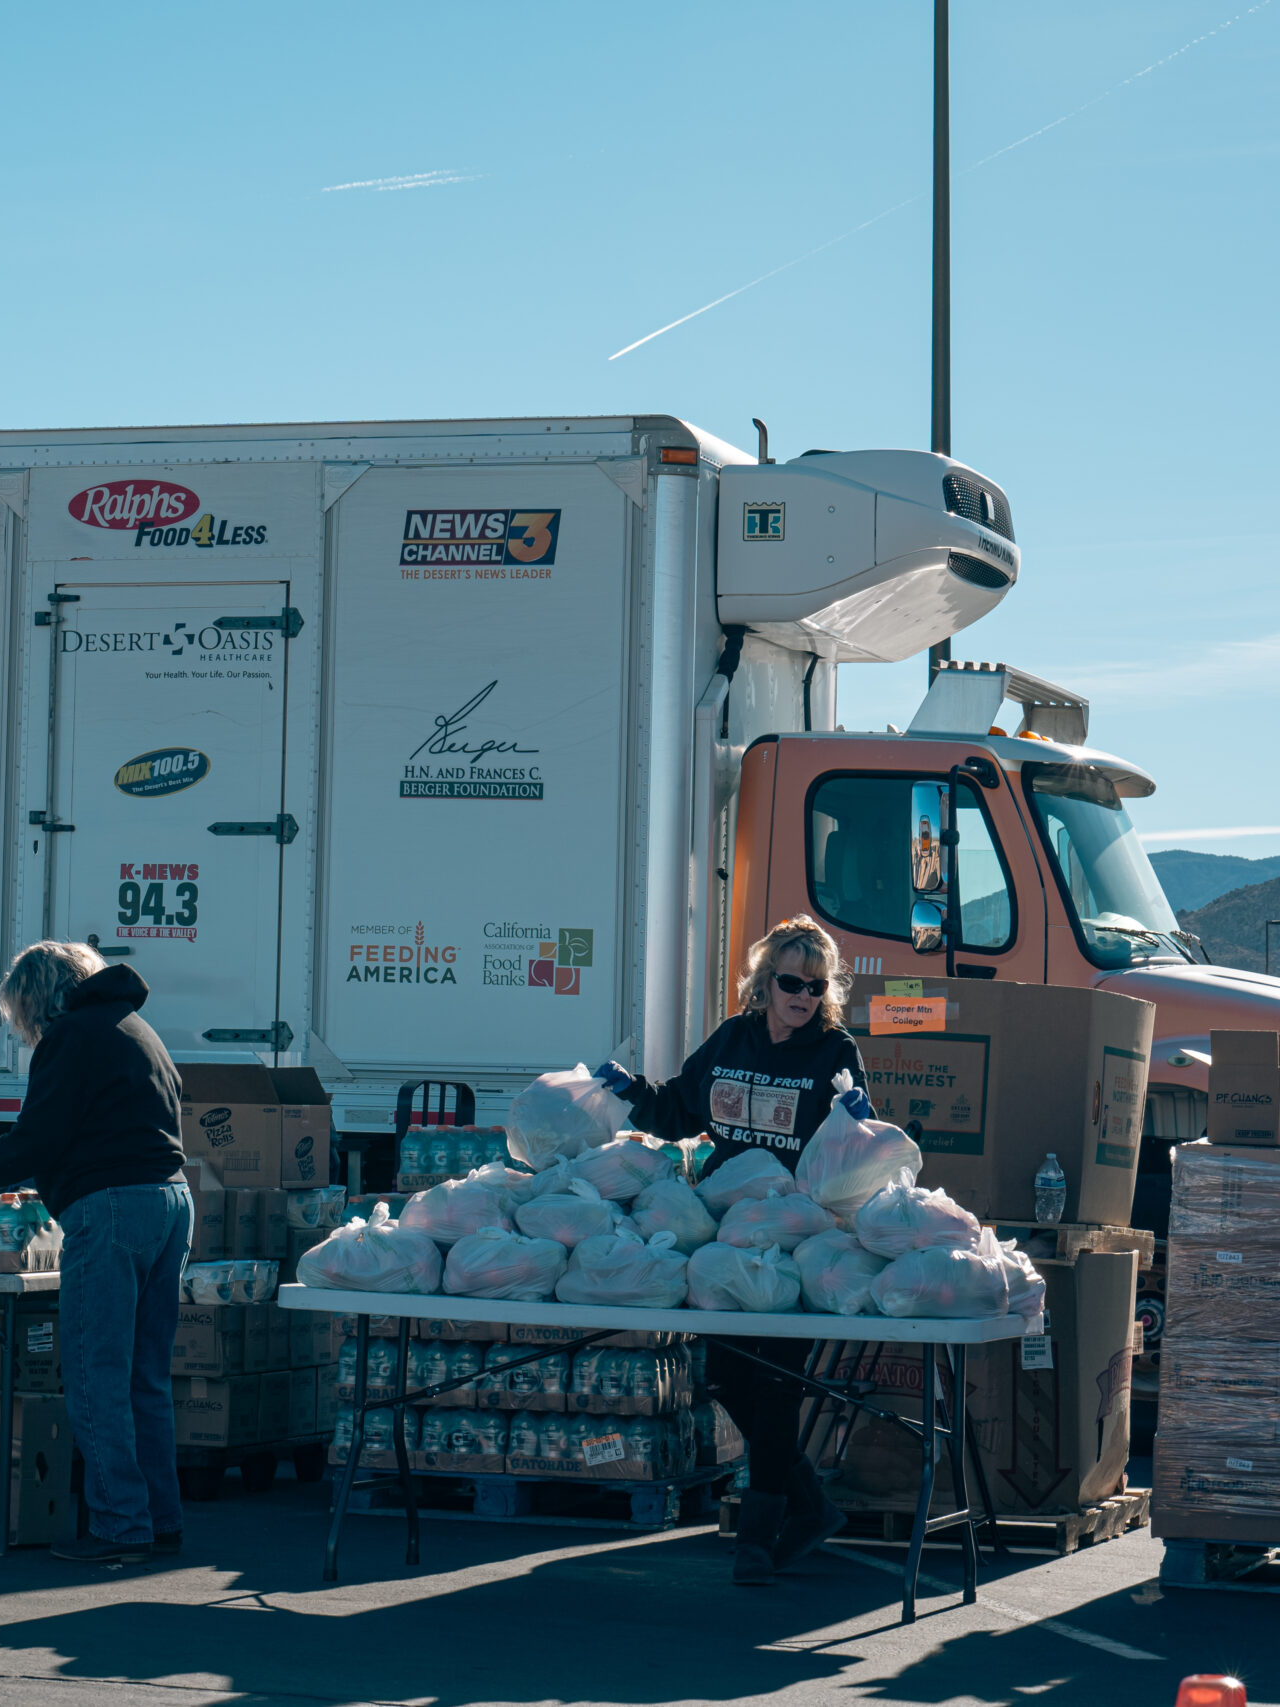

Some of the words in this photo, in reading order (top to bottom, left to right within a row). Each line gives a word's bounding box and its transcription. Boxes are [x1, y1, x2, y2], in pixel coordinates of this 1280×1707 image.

[80, 484, 187, 528] Ralphs
[407, 512, 506, 539] NEWS
[506, 512, 556, 563] 3
[403, 543, 502, 562] CHANNEL
[400, 569, 420, 580] THE
[423, 569, 471, 580] DESERT'S
[474, 569, 507, 579] NEWS
[510, 568, 552, 579] LEADER
[61, 629, 161, 653] DESERT
[198, 626, 274, 651] OASIS
[199, 653, 273, 662] HEALTHCARE
[145, 671, 162, 680] Your
[163, 670, 189, 679] Health.
[191, 670, 208, 679] Your
[209, 670, 225, 679] Life.
[226, 670, 241, 679] Our
[242, 670, 272, 679] Passion.
[117, 761, 153, 785] MIX
[151, 751, 201, 778] 100.5
[404, 765, 433, 779] H.N.
[437, 767, 466, 780] AND
[469, 766, 526, 780] FRANCES
[528, 767, 542, 780] C.
[144, 781, 168, 792] Desert's
[168, 778, 181, 786] Best
[182, 776, 194, 784] Mix
[402, 783, 451, 796] BERGER
[453, 784, 541, 797] FOUNDATION
[120, 863, 200, 881] K-NEWS
[117, 881, 199, 927] 94.3
[118, 927, 129, 937] THE
[130, 927, 149, 937] VOICE
[149, 928, 158, 937] OF
[158, 928, 170, 937] THE
[171, 928, 196, 938] VALLEY
[351, 925, 395, 935] MEMBER
[397, 925, 413, 935] OF
[482, 922, 552, 940] California
[349, 945, 458, 965] FEEDING
[483, 943, 524, 951] ASSOCIATION
[482, 955, 522, 971] Food
[346, 965, 457, 984] AMERICA
[482, 970, 525, 987] Banks
[885, 1004, 915, 1014] Copper
[917, 1005, 933, 1014] Mtn
[892, 1016, 924, 1027] College
[928, 1064, 949, 1073] THE
[711, 1065, 771, 1085] STARTED
[772, 1076, 815, 1091] FROM
[766, 1091, 796, 1101] COUPON
[205, 1124, 232, 1140] Pizza
[709, 1121, 730, 1140] THE
[732, 1127, 801, 1152] BOTTOM
[511, 1457, 582, 1472] GATORADE
